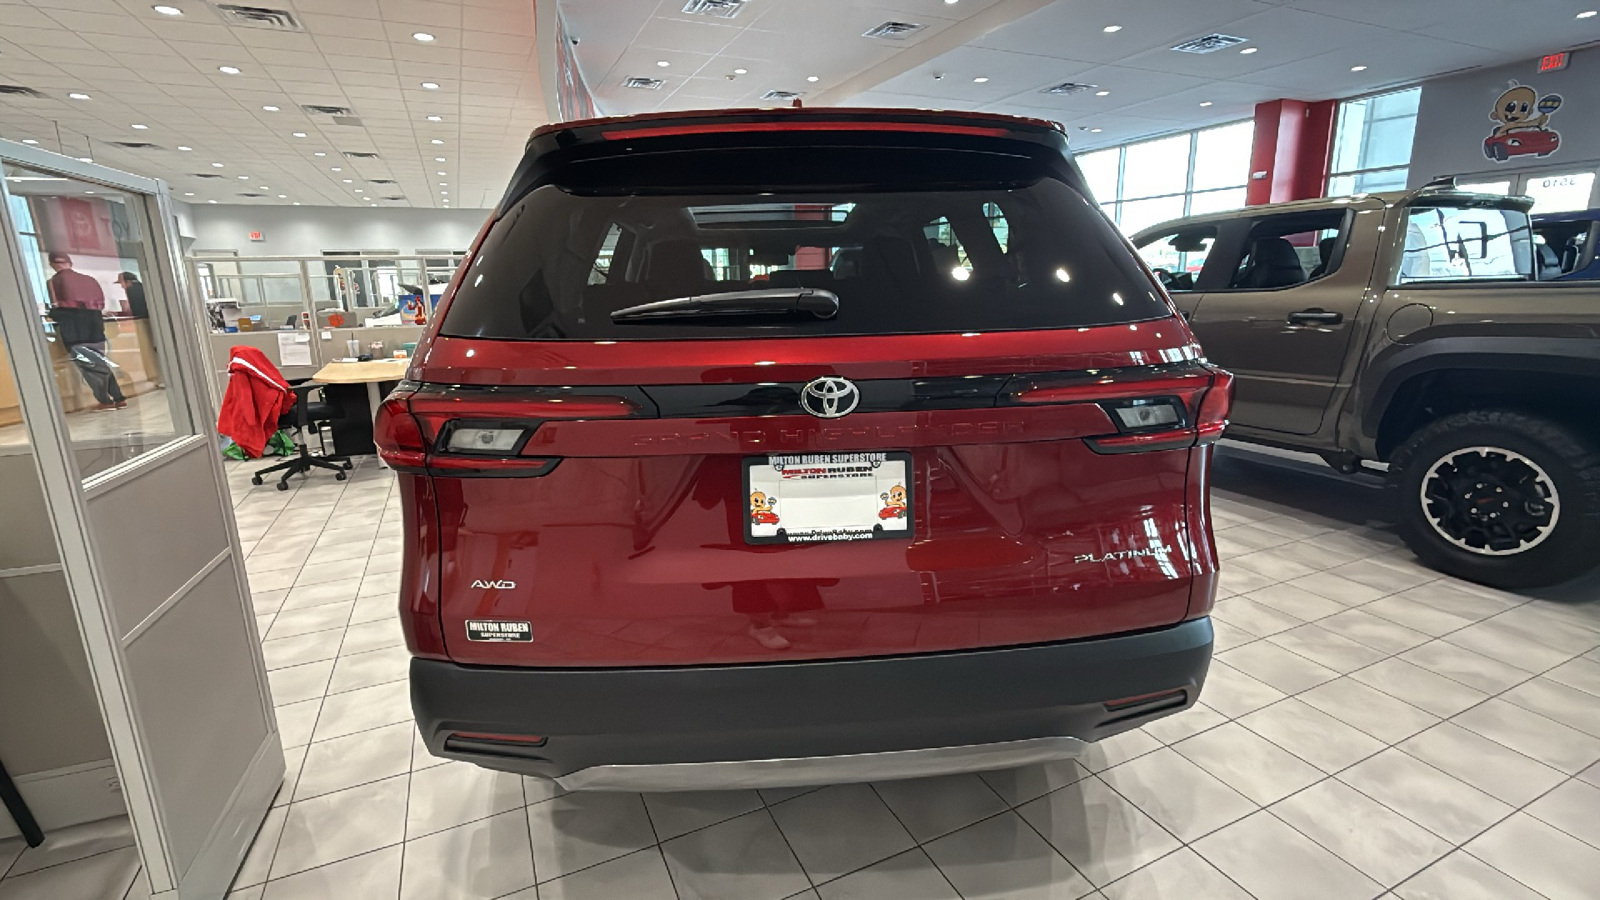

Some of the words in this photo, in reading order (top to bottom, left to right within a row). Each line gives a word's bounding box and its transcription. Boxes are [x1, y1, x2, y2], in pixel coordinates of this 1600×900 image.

[1541, 52, 1565, 71] EXIT
[768, 455, 801, 465] MILTON
[802, 454, 830, 464] RUBEN
[832, 452, 887, 463] SUPERSTORE
[782, 467, 826, 475] MILTON
[788, 532, 873, 543] www.drivebaby.com
[1073, 544, 1173, 564] PLATINUM
[470, 579, 516, 589] AWD
[469, 622, 500, 632] MILTON
[500, 622, 529, 632] RUBEN
